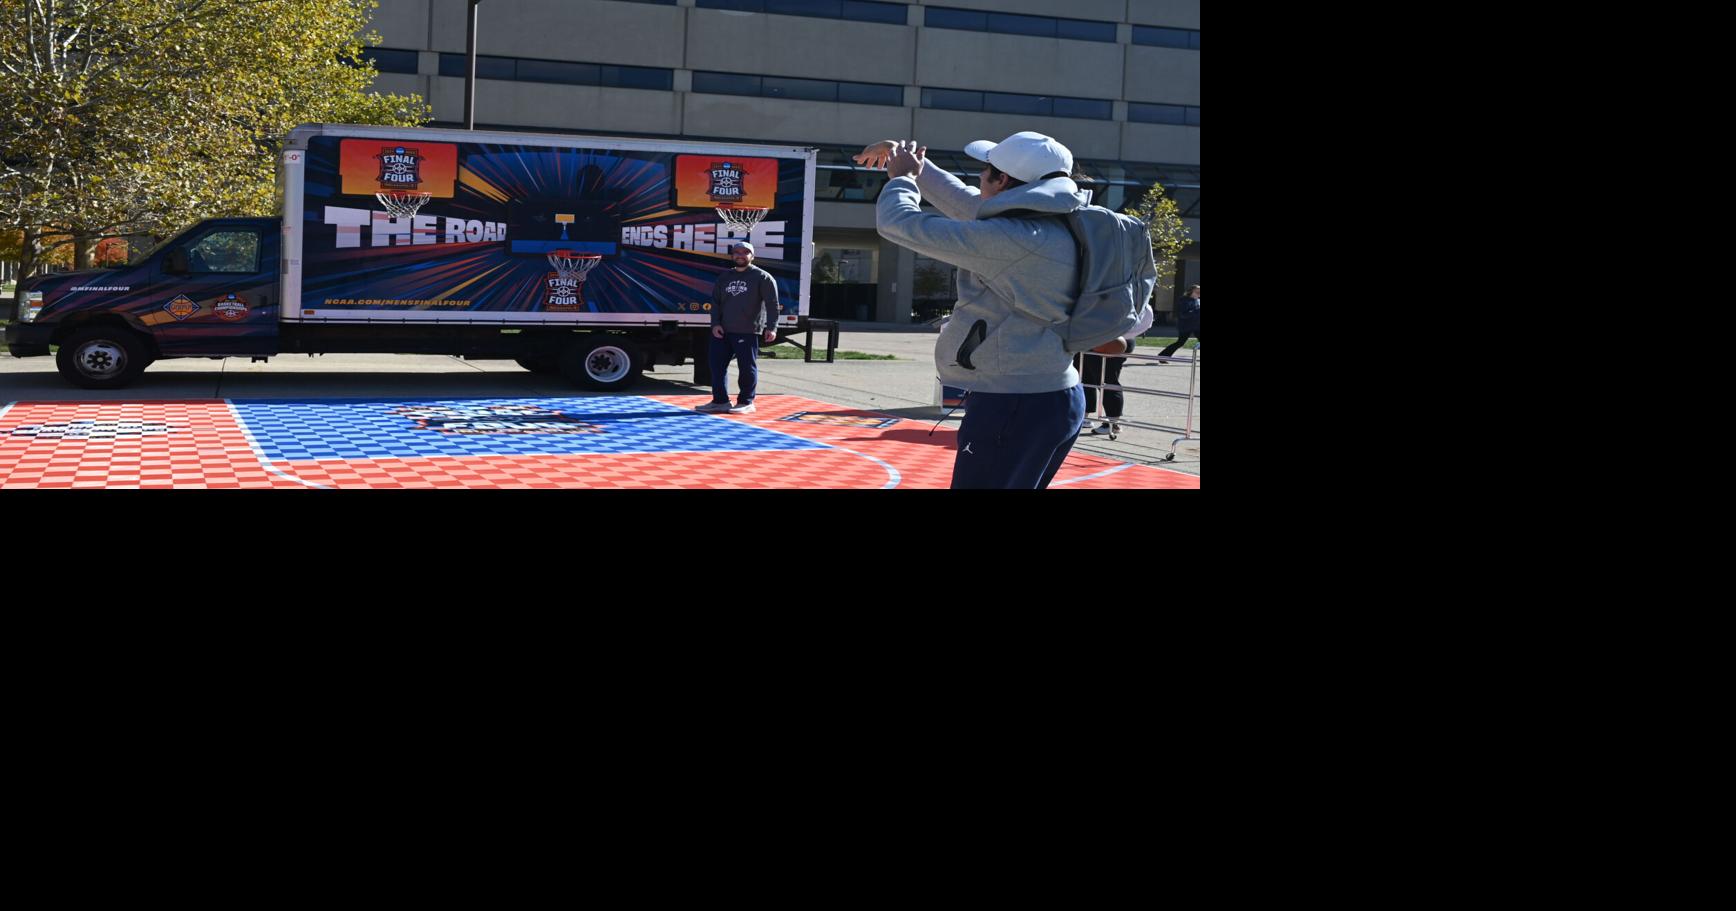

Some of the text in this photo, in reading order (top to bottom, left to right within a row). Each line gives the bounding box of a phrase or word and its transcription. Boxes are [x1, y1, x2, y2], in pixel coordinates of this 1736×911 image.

[383, 154, 415, 165] FINAL
[383, 172, 415, 183] FOUR
[712, 169, 740, 179] FINAL
[713, 186, 740, 196] FOUR
[324, 205, 785, 260] THE ROAD ENDS HERE
[548, 277, 579, 288] FINAL
[324, 298, 472, 307] NCAA.COM/MENSFINALFOUR
[548, 295, 577, 305] FOUR
